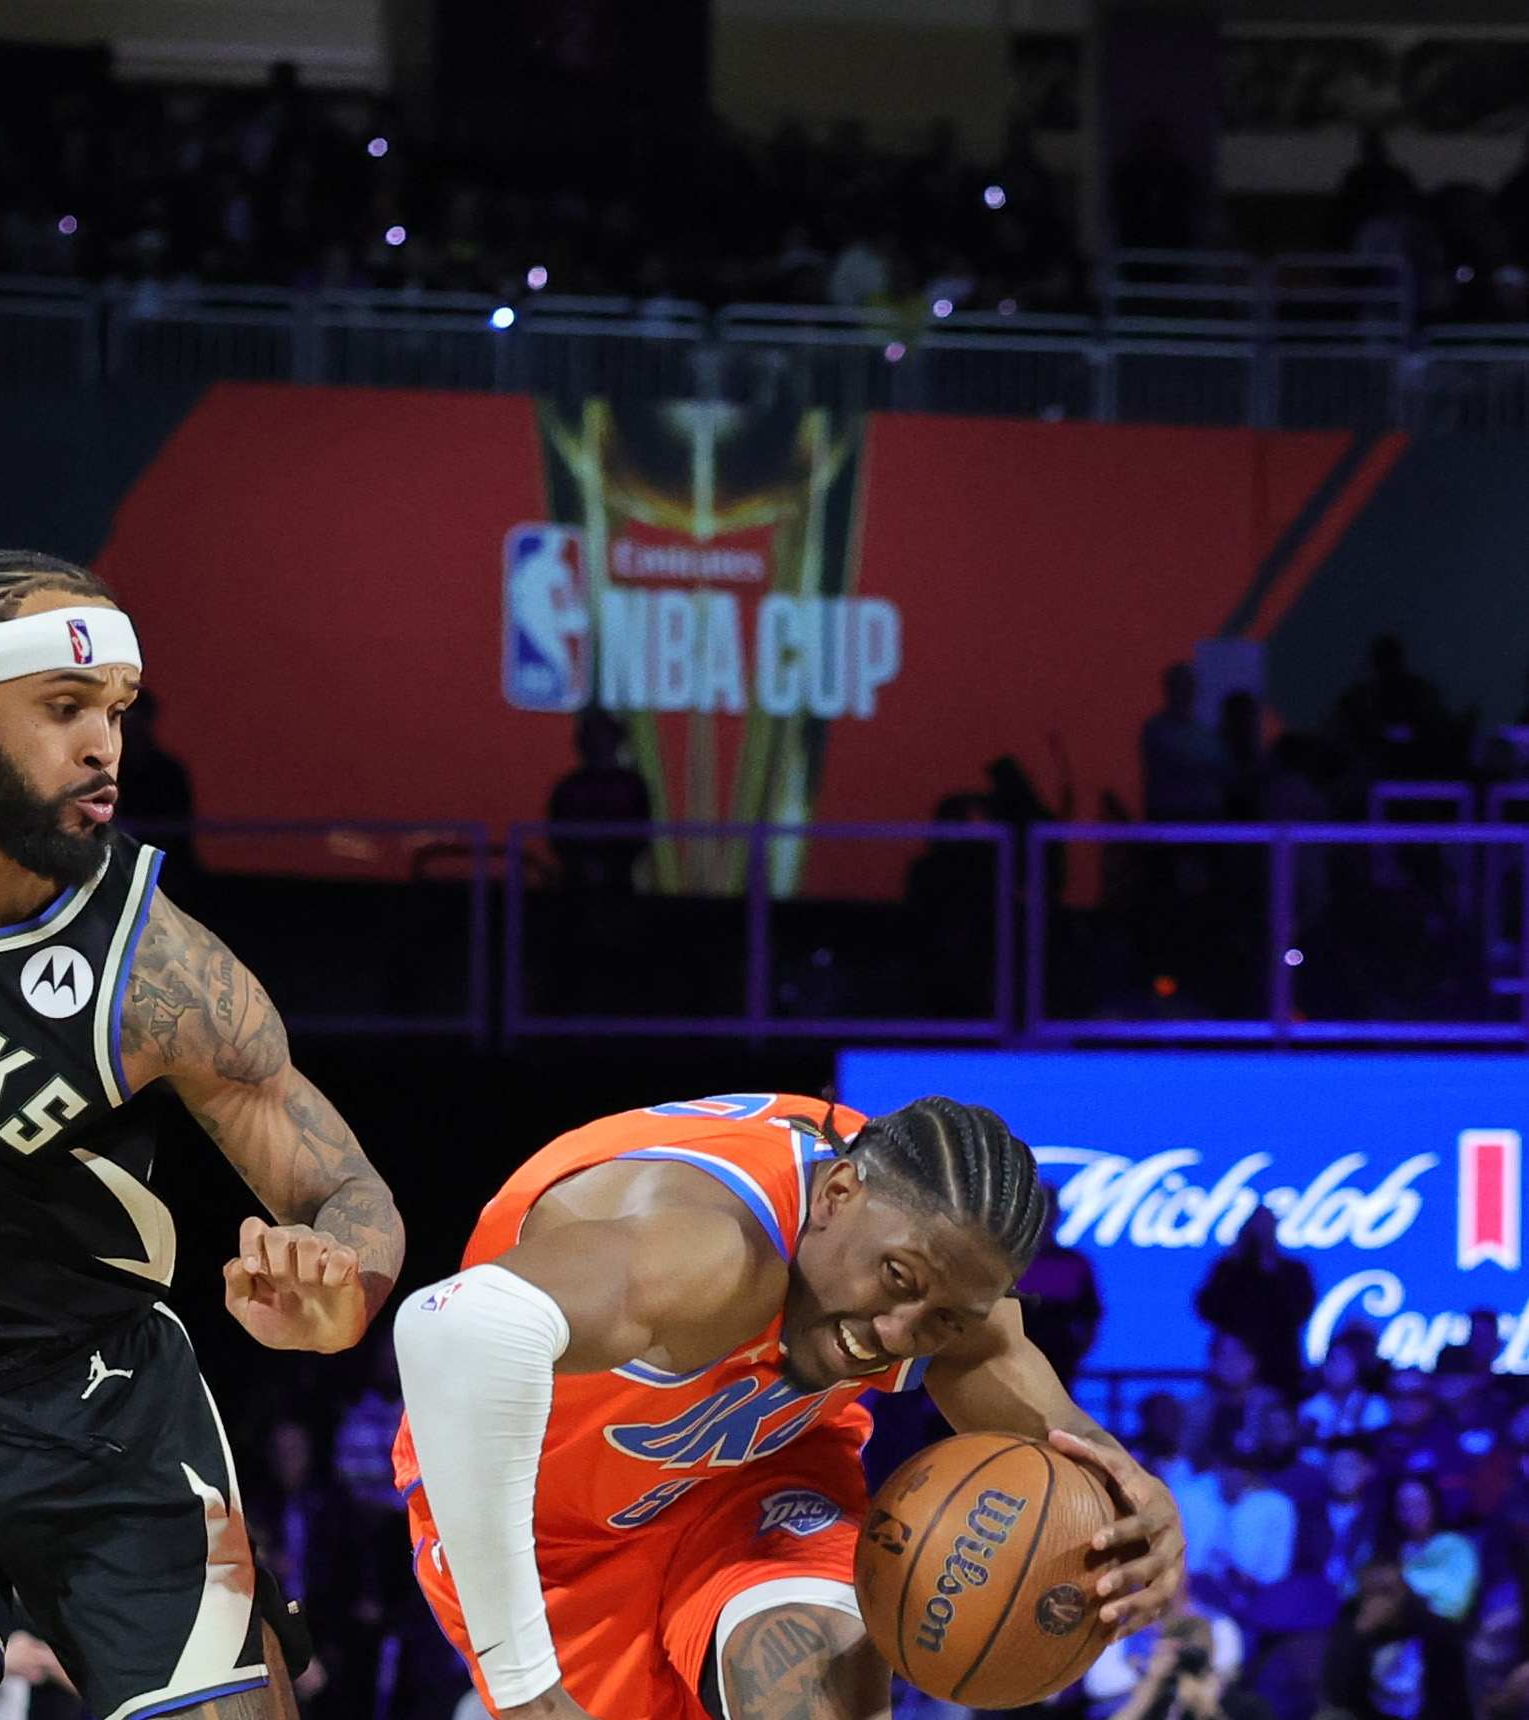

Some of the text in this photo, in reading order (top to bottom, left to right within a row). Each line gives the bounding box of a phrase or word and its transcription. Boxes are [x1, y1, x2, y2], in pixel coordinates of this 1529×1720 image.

[599, 589, 903, 720] NBA CUP
[916, 1488, 1027, 1652] Wilson
